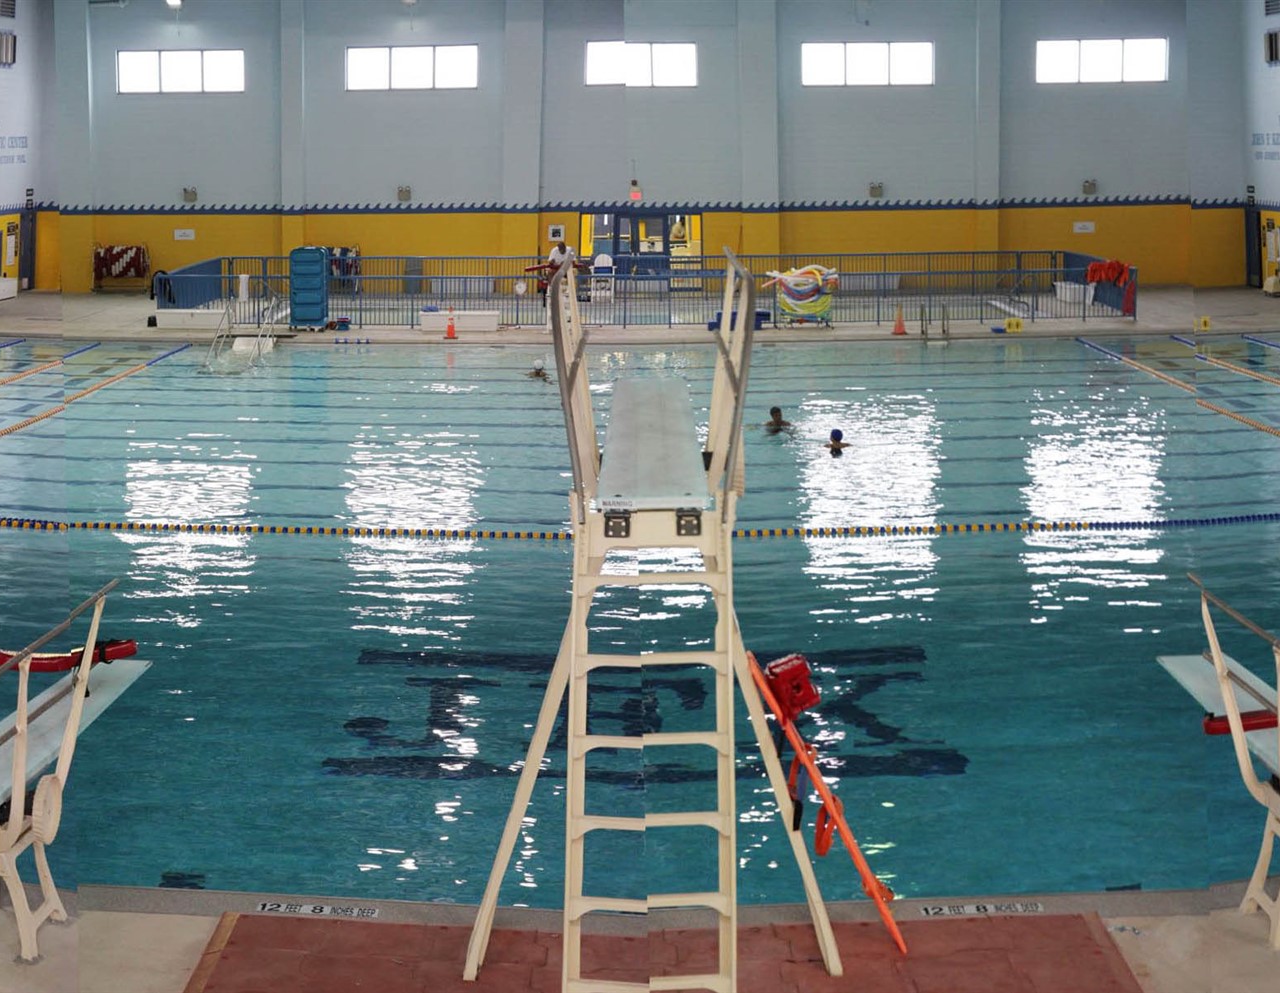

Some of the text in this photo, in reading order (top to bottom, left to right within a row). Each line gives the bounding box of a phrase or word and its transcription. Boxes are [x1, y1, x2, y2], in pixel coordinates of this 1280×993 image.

[260, 903, 376, 917] 12 FEET 8 INCHES DEEP
[922, 902, 1040, 915] 12 FEET 8 INCHES DEEP
